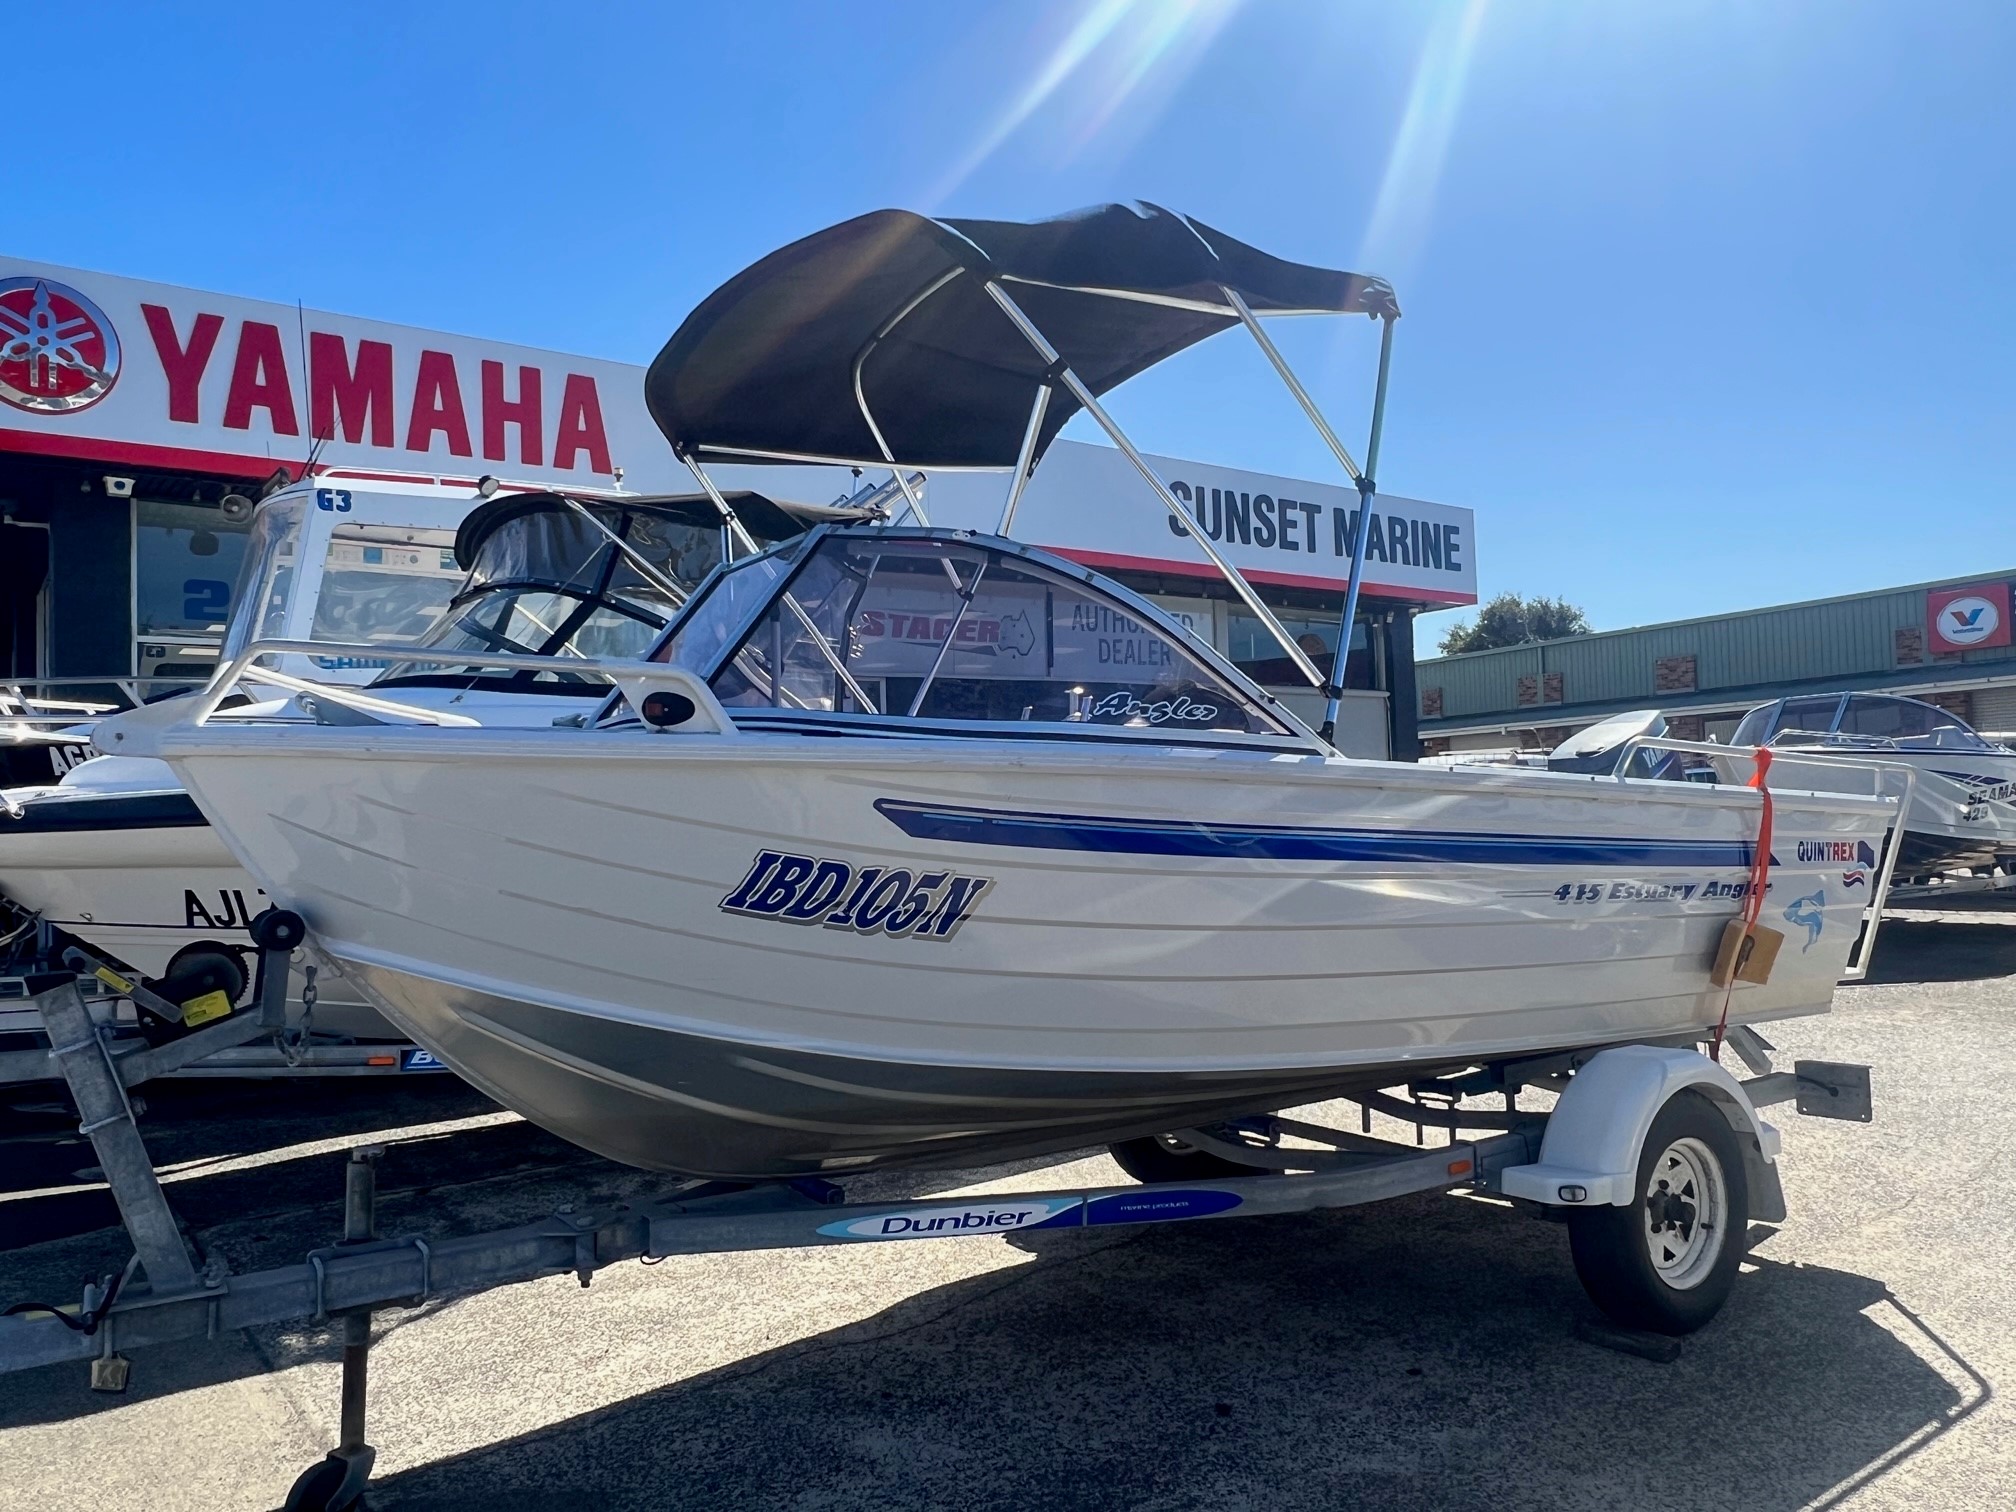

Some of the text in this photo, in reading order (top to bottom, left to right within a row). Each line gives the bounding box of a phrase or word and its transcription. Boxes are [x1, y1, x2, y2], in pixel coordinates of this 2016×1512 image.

[141, 303, 613, 475] YAMAHA
[317, 488, 353, 513] G3
[1168, 480, 1462, 572] SUNSET MARINE
[1098, 638, 1171, 666] DEALER
[1093, 692, 1218, 724] Angler
[1797, 840, 1855, 862] QUINTREX
[717, 848, 993, 940] IBD105N
[1554, 882, 1604, 903] 415
[1608, 881, 1700, 903] Estuary
[881, 1209, 1033, 1235] Dunbier
